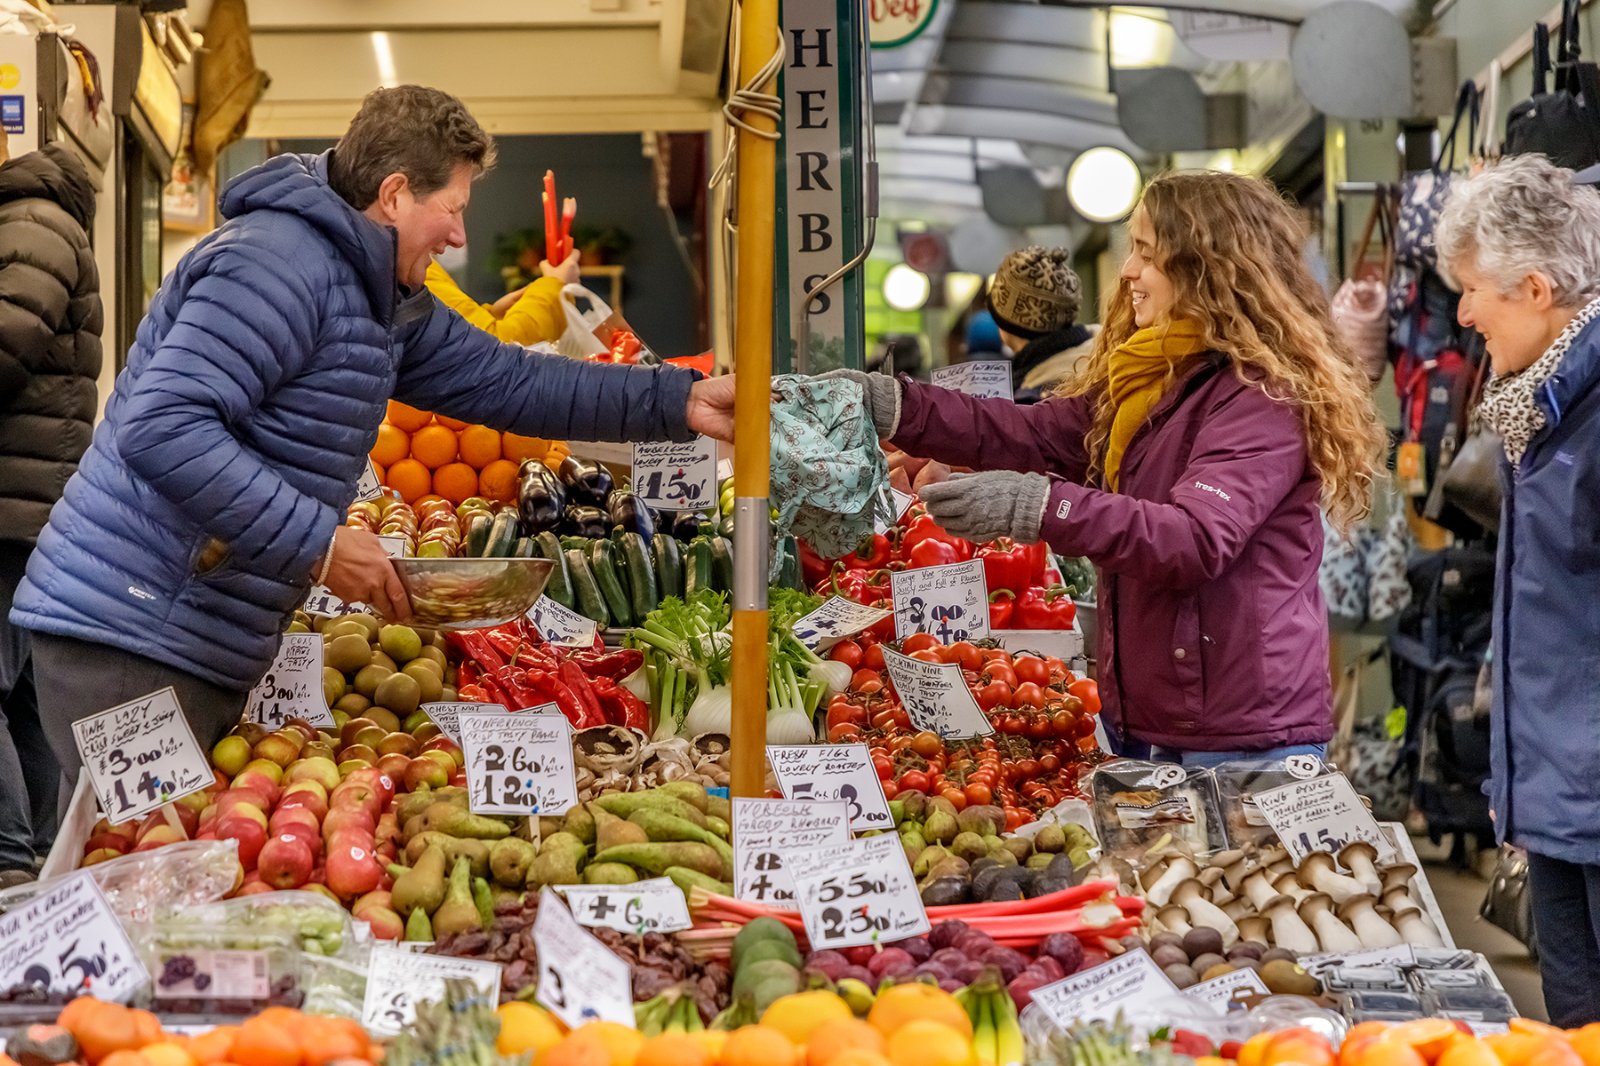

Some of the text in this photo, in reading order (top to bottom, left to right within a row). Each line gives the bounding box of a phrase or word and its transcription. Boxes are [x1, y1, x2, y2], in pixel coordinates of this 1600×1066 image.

[789, 29, 833, 314] HERBS
[1195, 481, 1231, 502] tres-tex
[773, 749, 849, 760] FRESH FIGS
